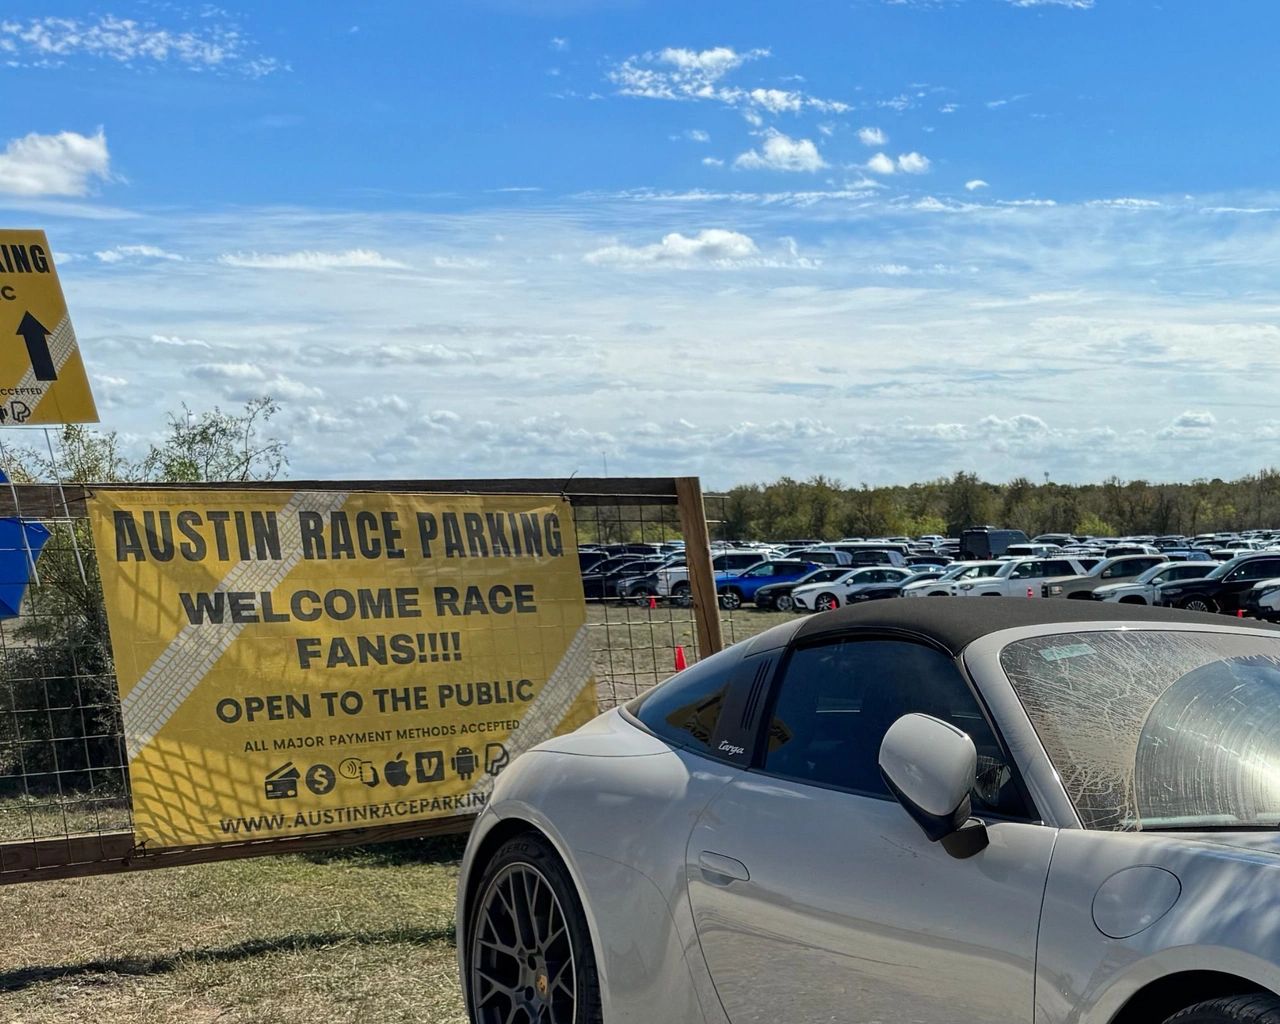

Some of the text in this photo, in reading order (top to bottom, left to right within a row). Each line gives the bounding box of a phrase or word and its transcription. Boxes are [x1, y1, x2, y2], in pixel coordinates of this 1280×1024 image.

[0, 387, 42, 396] CCEPTED
[113, 511, 564, 562] AUSTIN RACE PARKING
[179, 584, 537, 625] WELCOME RACE
[296, 632, 462, 669] FANS!!!!
[216, 679, 534, 723] OPEN TO THE PUBLIC
[244, 720, 520, 752] ALL MAJOR PAYMENT METHODS ACCEPTED
